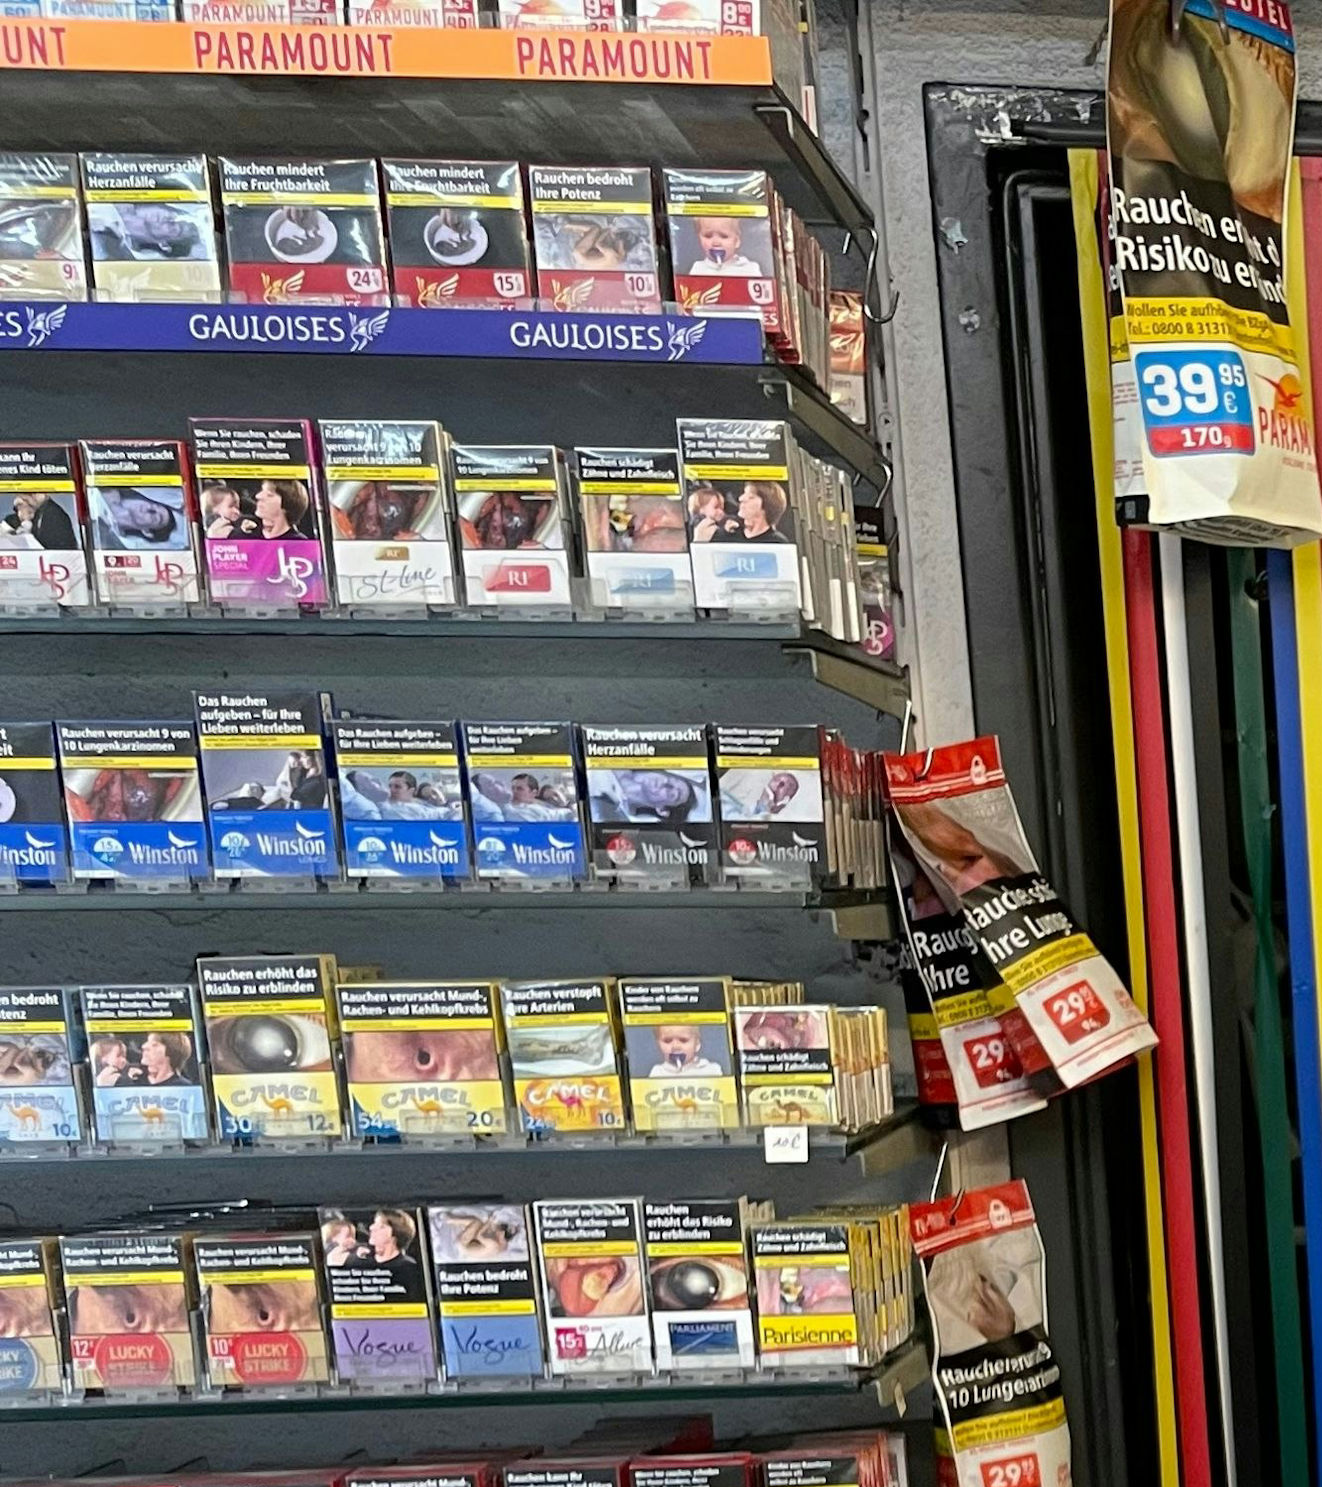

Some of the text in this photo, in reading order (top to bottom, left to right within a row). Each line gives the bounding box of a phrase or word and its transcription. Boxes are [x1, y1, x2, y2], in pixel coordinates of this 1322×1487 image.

[194, 31, 392, 72] PARAMOUNT
[517, 37, 711, 79] PARAMOUNT
[223, 163, 324, 177] Rauchen mindert
[224, 178, 331, 192] Ihre Fruchtbarkeit
[535, 172, 633, 186] Rauchen bedroht
[535, 187, 601, 200] Ihre Potenz
[189, 315, 345, 341] GAULOISES
[510, 322, 664, 351] GAULOISES
[1142, 363, 1218, 416] 39
[199, 696, 267, 707] Das Rauchen
[201, 709, 301, 721] aufgeben für Ihre
[202, 722, 305, 734] Lieben weiterleben
[257, 832, 326, 856] Winston
[204, 967, 317, 982] Rauchen erhöht das
[205, 982, 314, 995] Risiko zu erblinden
[230, 1085, 322, 1106] CAMEL
[764, 1327, 852, 1345] Parisienne
[244, 1344, 289, 1357] LUCKY
[341, 1328, 424, 1363] Vogue
[245, 1358, 292, 1372] STRIKE
